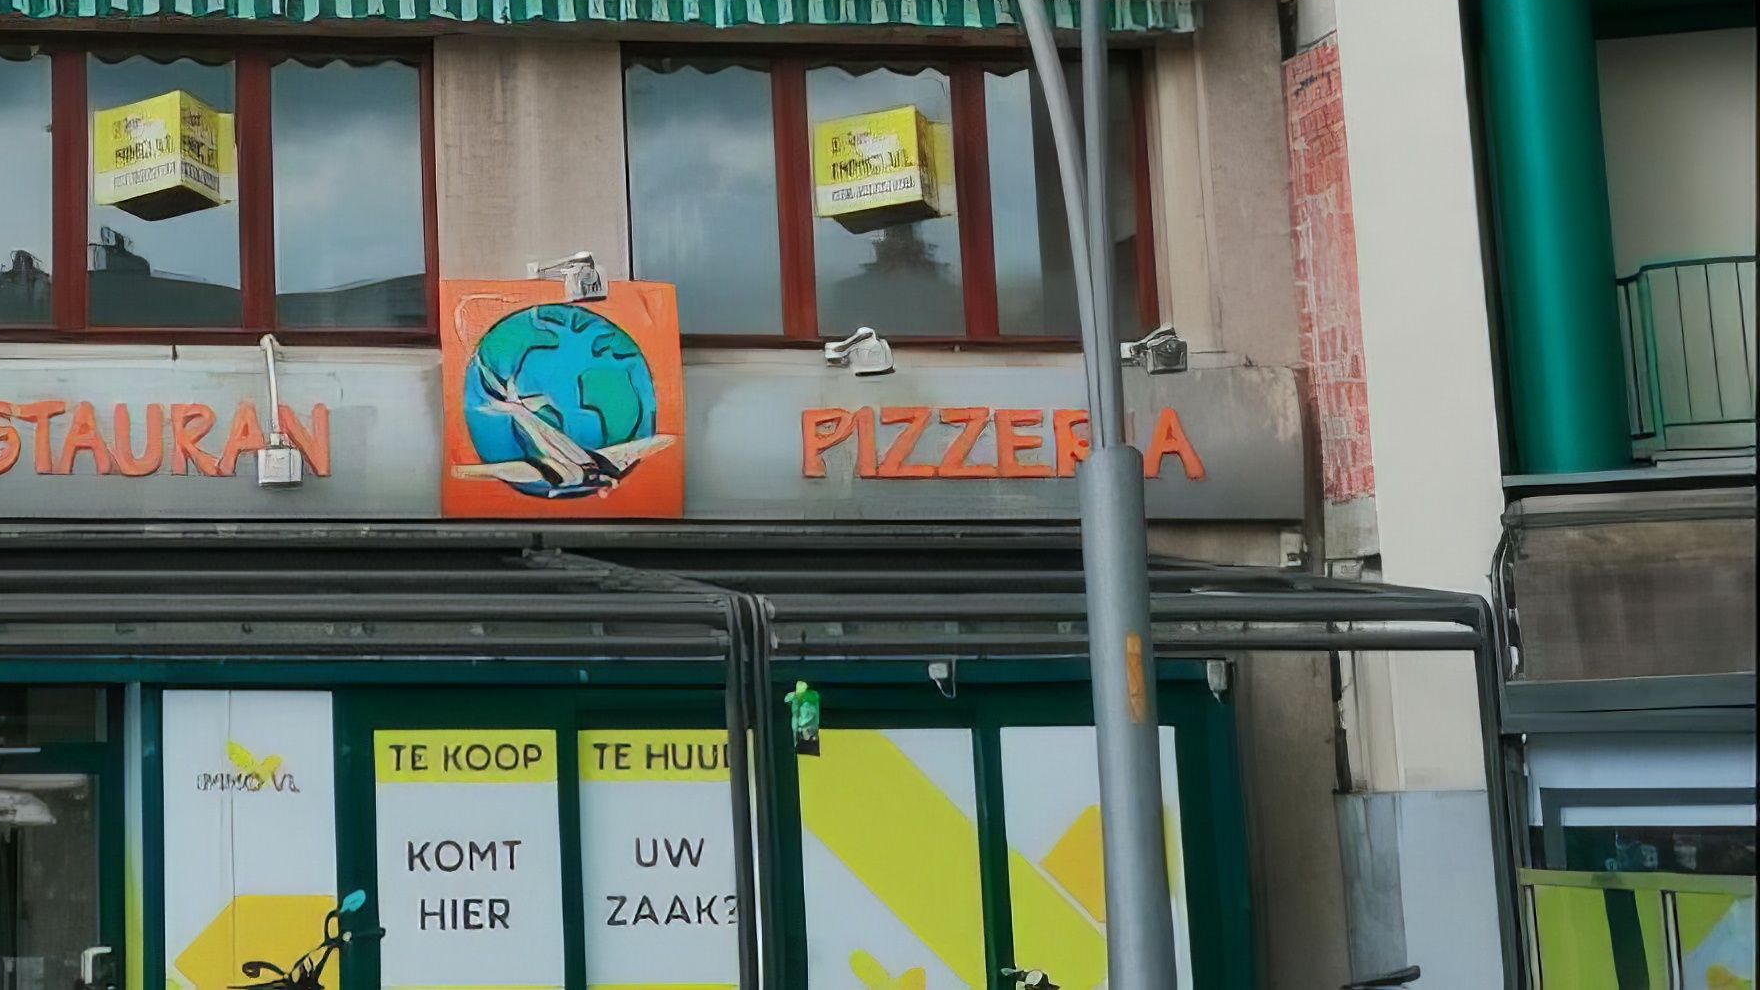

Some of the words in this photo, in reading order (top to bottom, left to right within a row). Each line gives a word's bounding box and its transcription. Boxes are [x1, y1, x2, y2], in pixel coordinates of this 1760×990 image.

[802, 406, 1206, 481] PIZZERA
[389, 745, 428, 771] TE
[443, 744, 542, 771] KOOP
[593, 743, 632, 770] TE
[407, 840, 522, 872] KOMT
[635, 837, 704, 868] UW
[420, 899, 510, 930] HIER
[606, 895, 738, 926] ZAAK?
